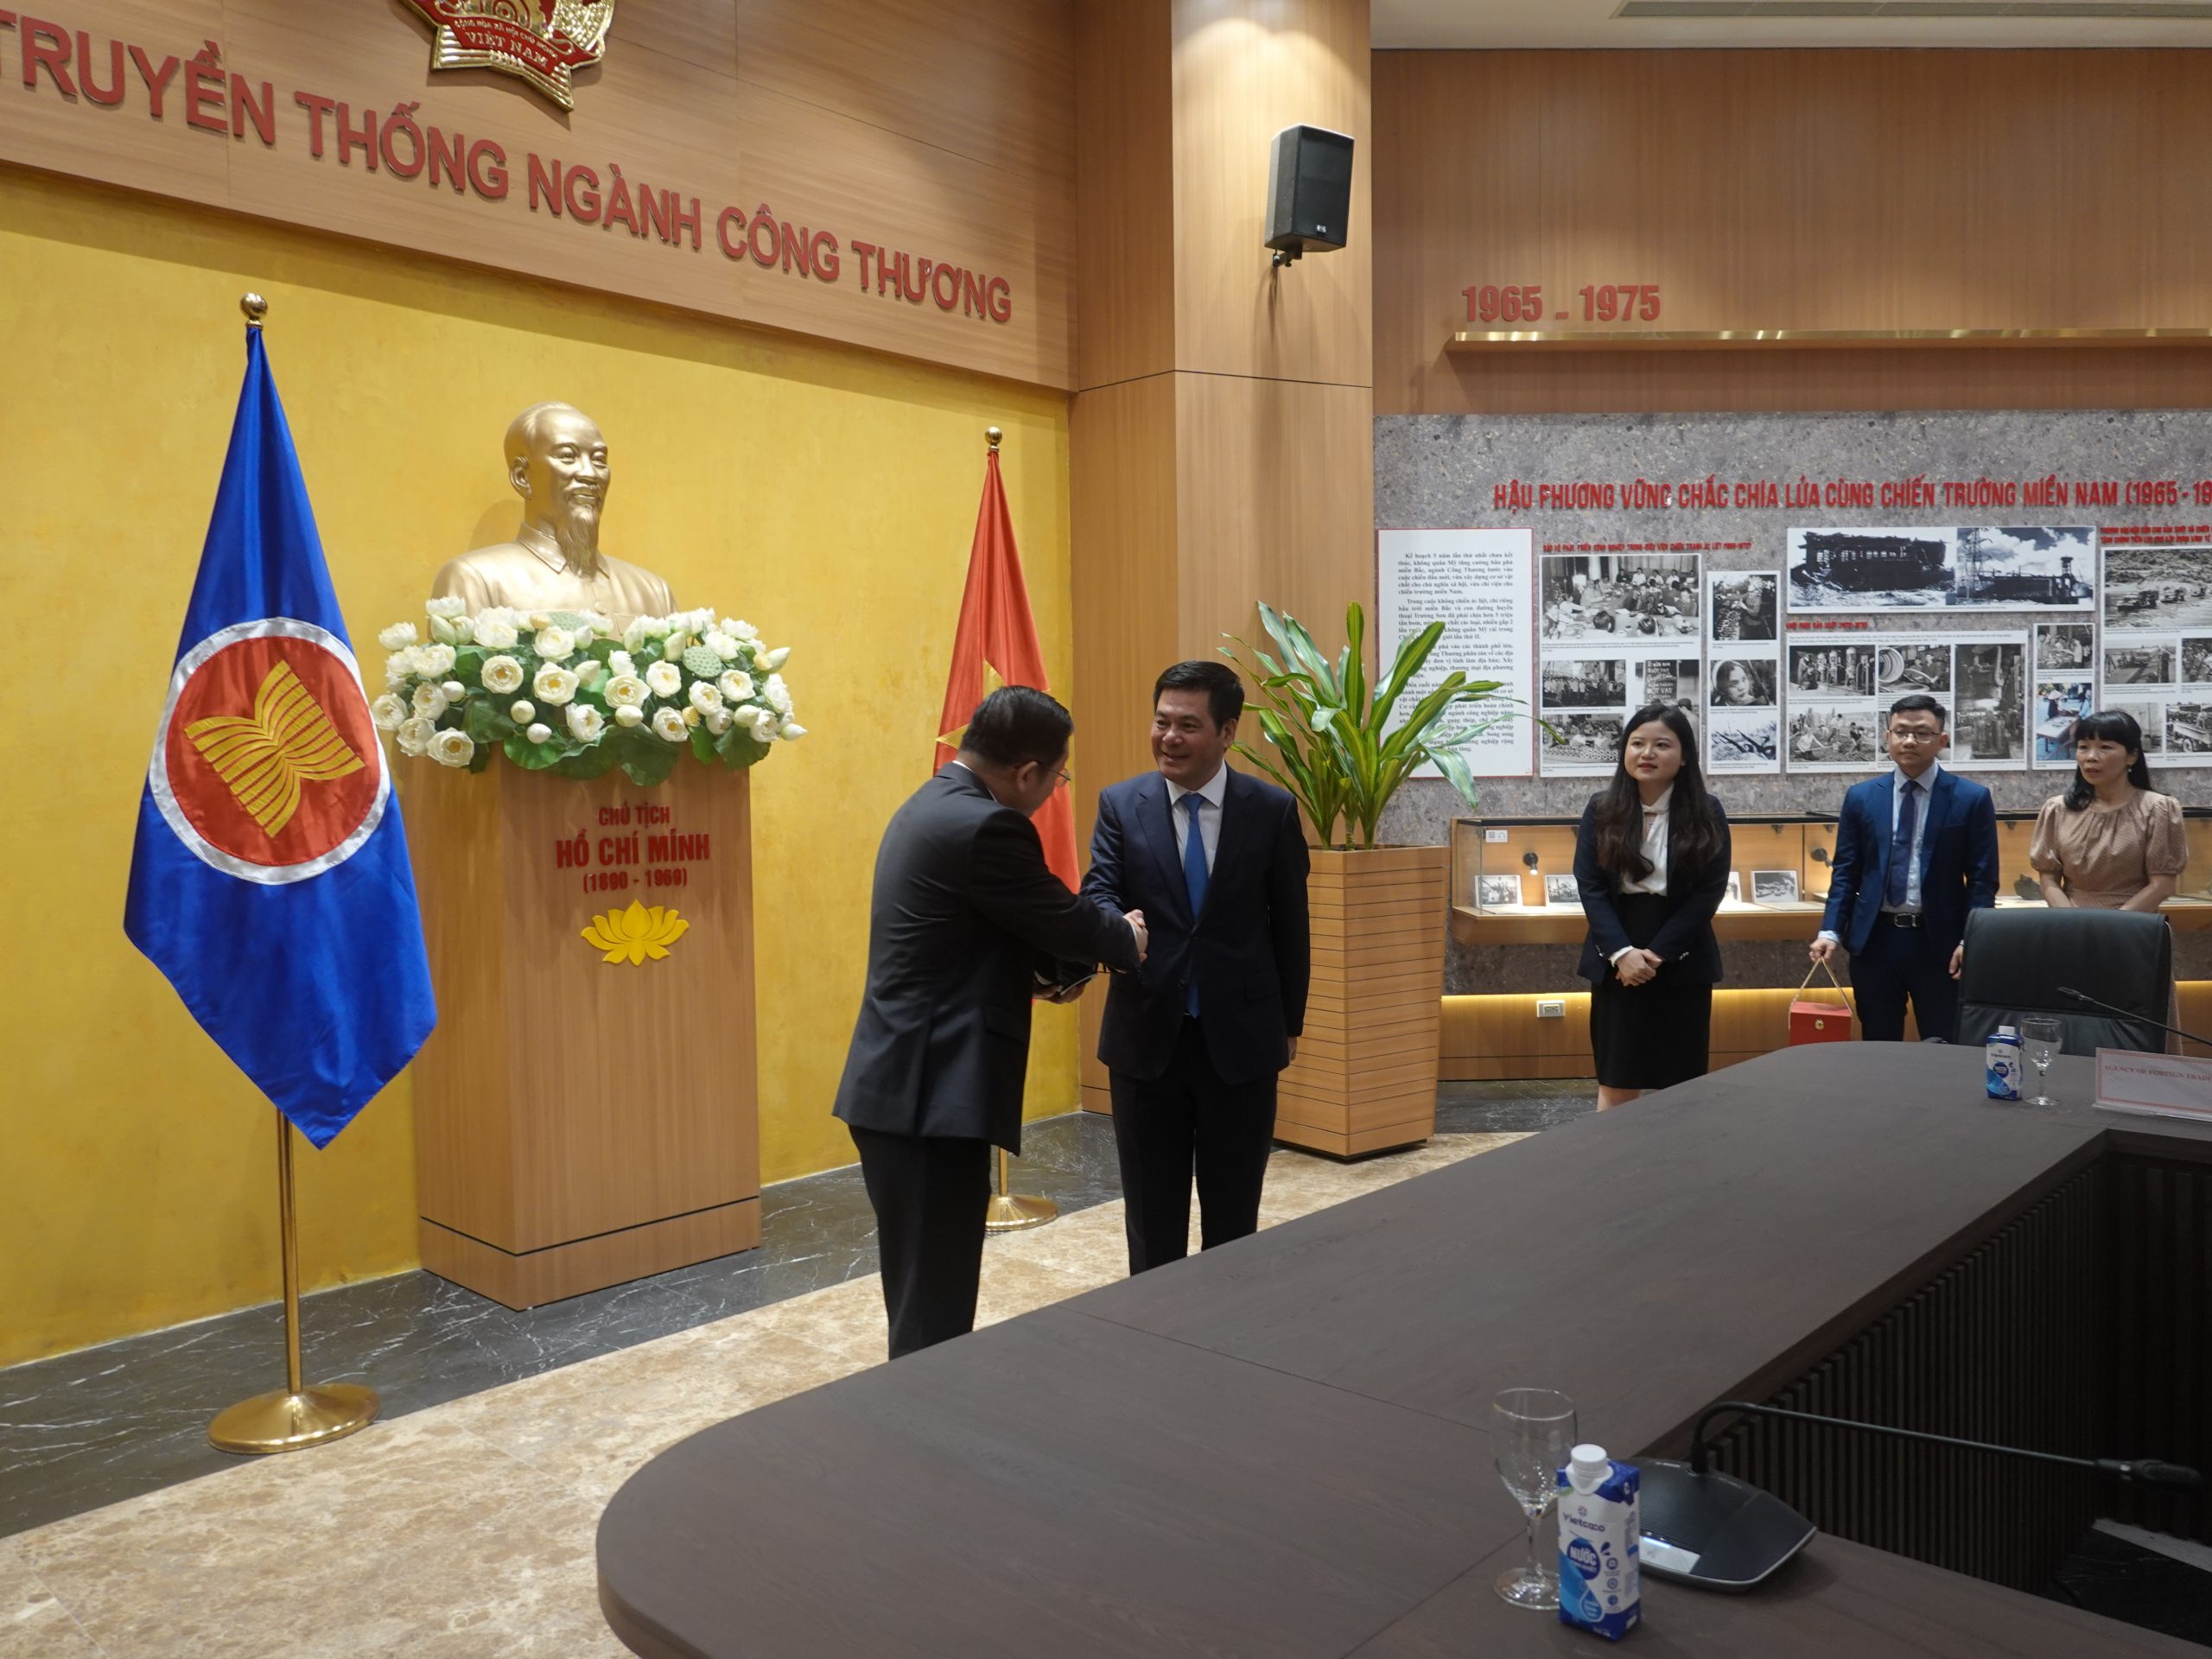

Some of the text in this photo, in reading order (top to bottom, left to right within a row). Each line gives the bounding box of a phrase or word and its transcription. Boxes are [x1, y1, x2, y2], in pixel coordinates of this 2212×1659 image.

[465, 31, 549, 67] VIỆT NAM
[295, 91, 509, 199] THỐNG
[528, 152, 702, 250] NGÀNH
[718, 202, 840, 282] CÔNG
[852, 240, 1012, 322] THƯƠNG
[1462, 285, 1542, 321] 1965
[1580, 285, 1660, 321] 1975
[1494, 479, 1533, 515] HẬU
[1539, 481, 1615, 509] PHƯƠNG
[1620, 478, 1672, 508] VŨNG
[1679, 474, 1728, 508] CHẮC
[1785, 474, 1821, 508] LỬA
[1826, 478, 1873, 508] CÙNG
[1880, 474, 1935, 508] CHIẾN
[1942, 477, 2016, 507] TRƯỜNG
[2075, 481, 2118, 507] NAM
[2126, 480, 2177, 507] (1965
[598, 800, 671, 828] CHỦ TỊCH
[556, 828, 589, 868] HỒ
[599, 830, 639, 866] CHÍ
[583, 871, 628, 893] (1890
[645, 868, 688, 887] 1969)
[2148, 1070, 2184, 1078] FOREIGN
[1562, 1512, 1605, 1532] Vietcoco
[1569, 1545, 1598, 1567] NƯỚC
